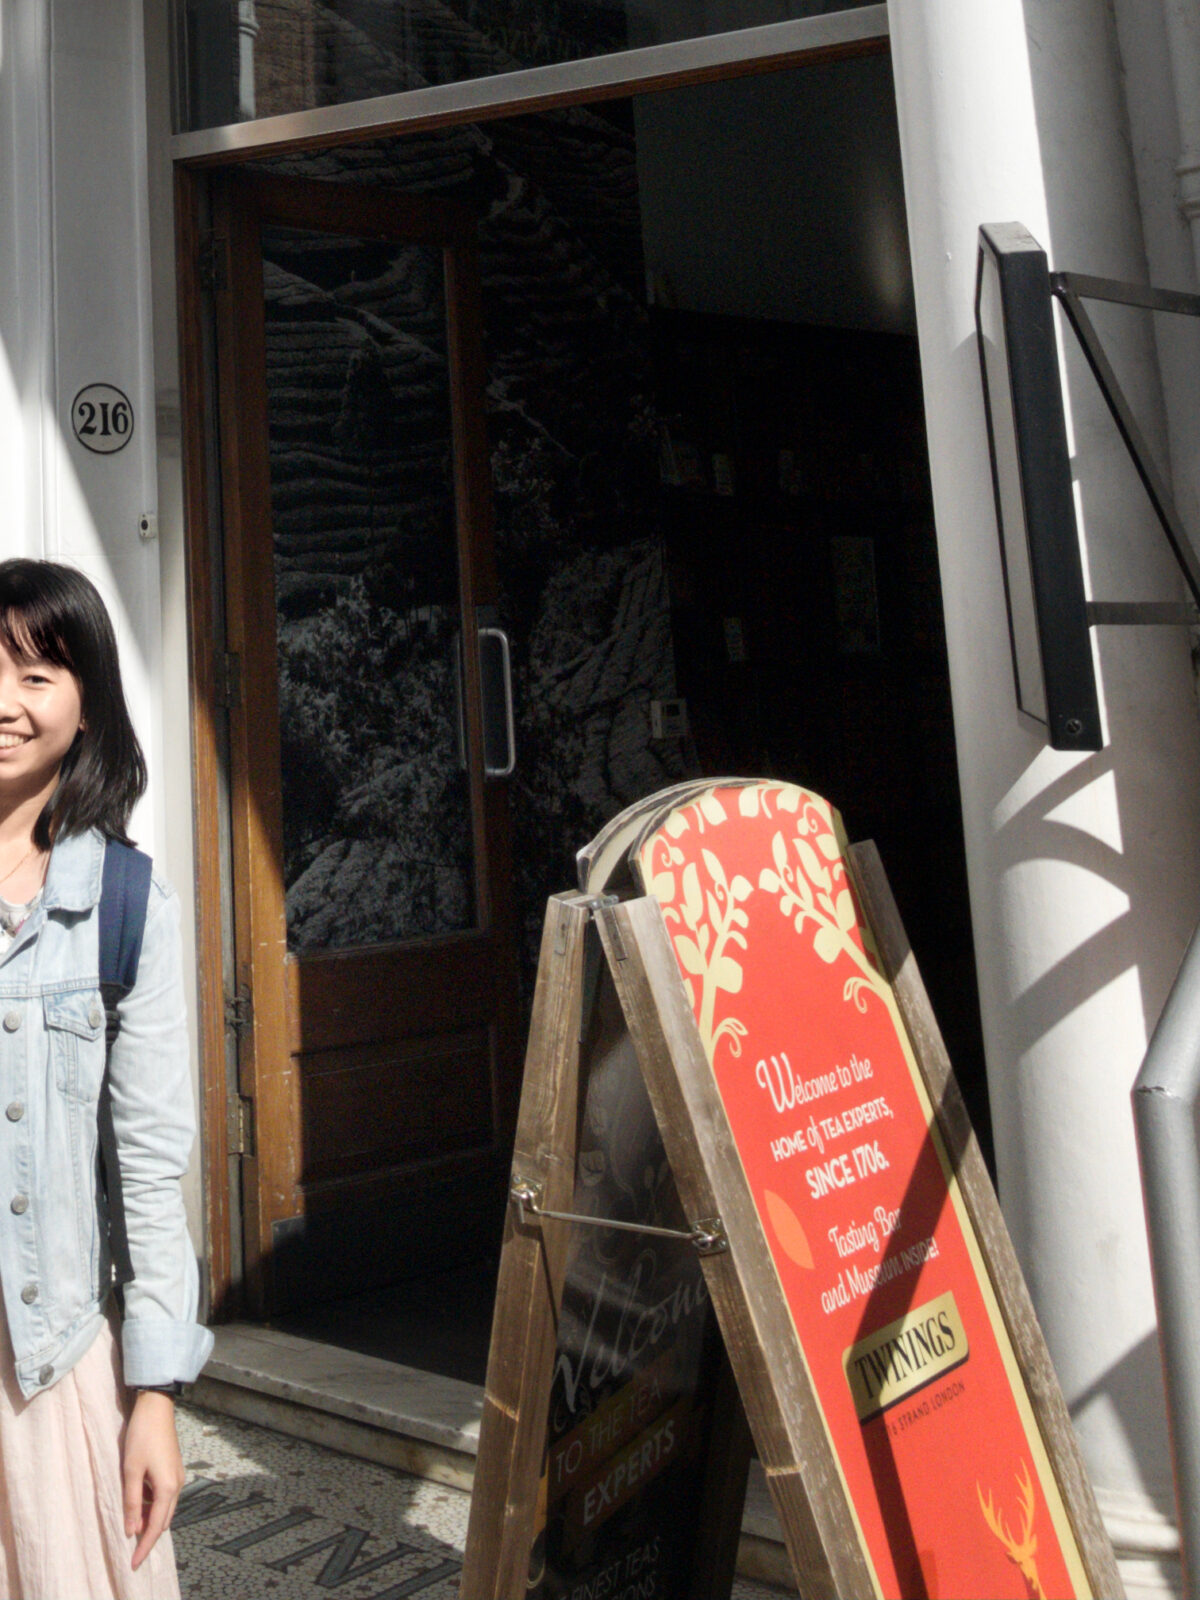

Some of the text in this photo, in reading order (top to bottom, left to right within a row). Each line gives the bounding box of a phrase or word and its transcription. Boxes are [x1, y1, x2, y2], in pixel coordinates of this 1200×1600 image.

[78, 402, 129, 436] 216
[756, 1052, 874, 1113] Welcome to the
[770, 1096, 894, 1162] HOME of TEA EXPERTS,
[805, 1140, 890, 1200] SINCE 1706.
[828, 1205, 901, 1259] Tasting Bar
[820, 1237, 940, 1315] and Museum INSIDE!
[853, 1311, 956, 1401] TWININGS
[898, 1401, 930, 1431] STRAND
[930, 1382, 965, 1411] LONDON
[556, 1438, 582, 1484] TO
[588, 1403, 622, 1457] THE
[583, 1419, 676, 1526] EXPERTS
